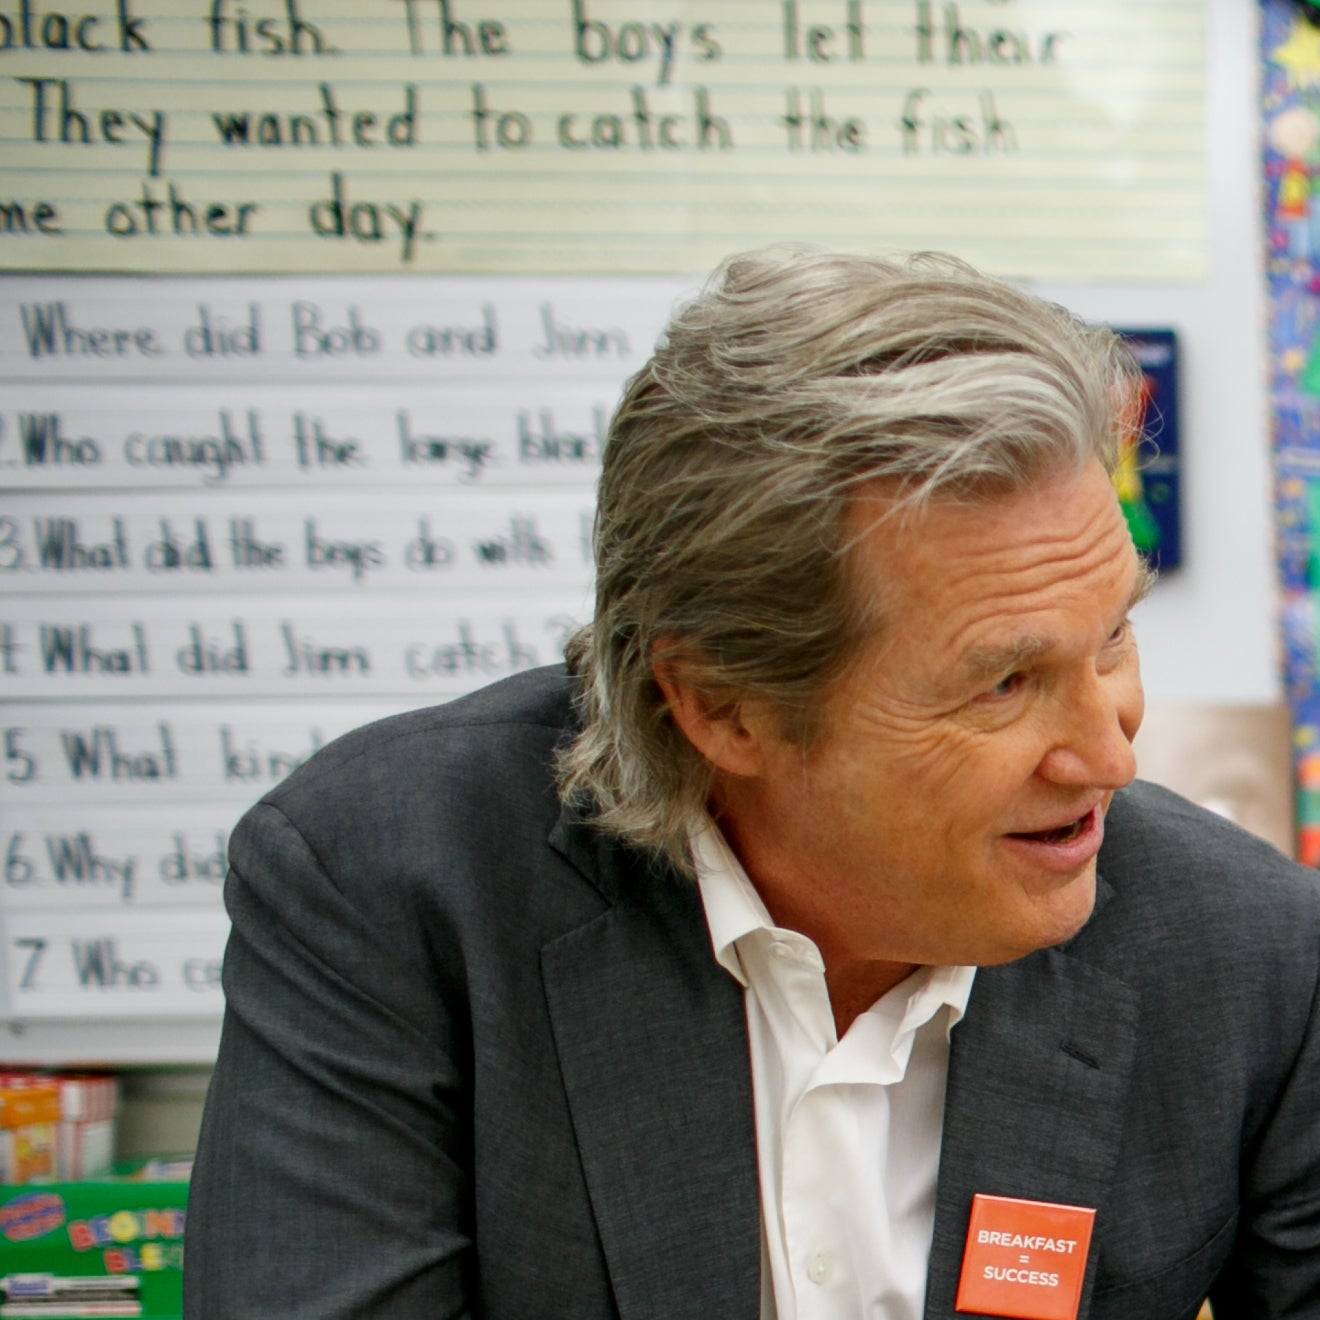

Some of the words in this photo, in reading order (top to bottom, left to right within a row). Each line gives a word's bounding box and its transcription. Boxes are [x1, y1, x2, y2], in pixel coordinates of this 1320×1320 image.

[572, 0, 722, 86] boys
[783, 0, 864, 62] let
[12, 76, 166, 177] They
[210, 82, 420, 150] wanted
[471, 83, 533, 152] to
[556, 86, 732, 150] catch
[778, 88, 868, 153] the
[895, 88, 1020, 155] fish
[106, 180, 258, 238] other
[308, 172, 437, 262] day.
[20, 299, 166, 360] Where
[184, 303, 262, 358] did
[292, 300, 383, 357] Bob
[406, 302, 500, 358] and
[530, 301, 632, 360] Jim
[18, 410, 104, 468] Who
[124, 408, 265, 485] caught
[295, 412, 370, 470] the
[396, 408, 500, 484] large
[34, 513, 130, 572] What
[145, 516, 213, 572] did
[229, 516, 285, 570] the
[305, 515, 385, 585] boys
[406, 515, 454, 572] do
[474, 510, 555, 570] with
[40, 619, 150, 675] What
[177, 618, 250, 676] did
[281, 620, 370, 677] Jim
[60, 721, 178, 779] What
[218, 722, 325, 780] kin
[46, 832, 134, 900] Why
[71, 935, 157, 988] Who
[977, 1230, 1077, 1254] BREAKFAST
[1018, 1254, 1030, 1264] =
[983, 1265, 1059, 1287] SUCCESS
